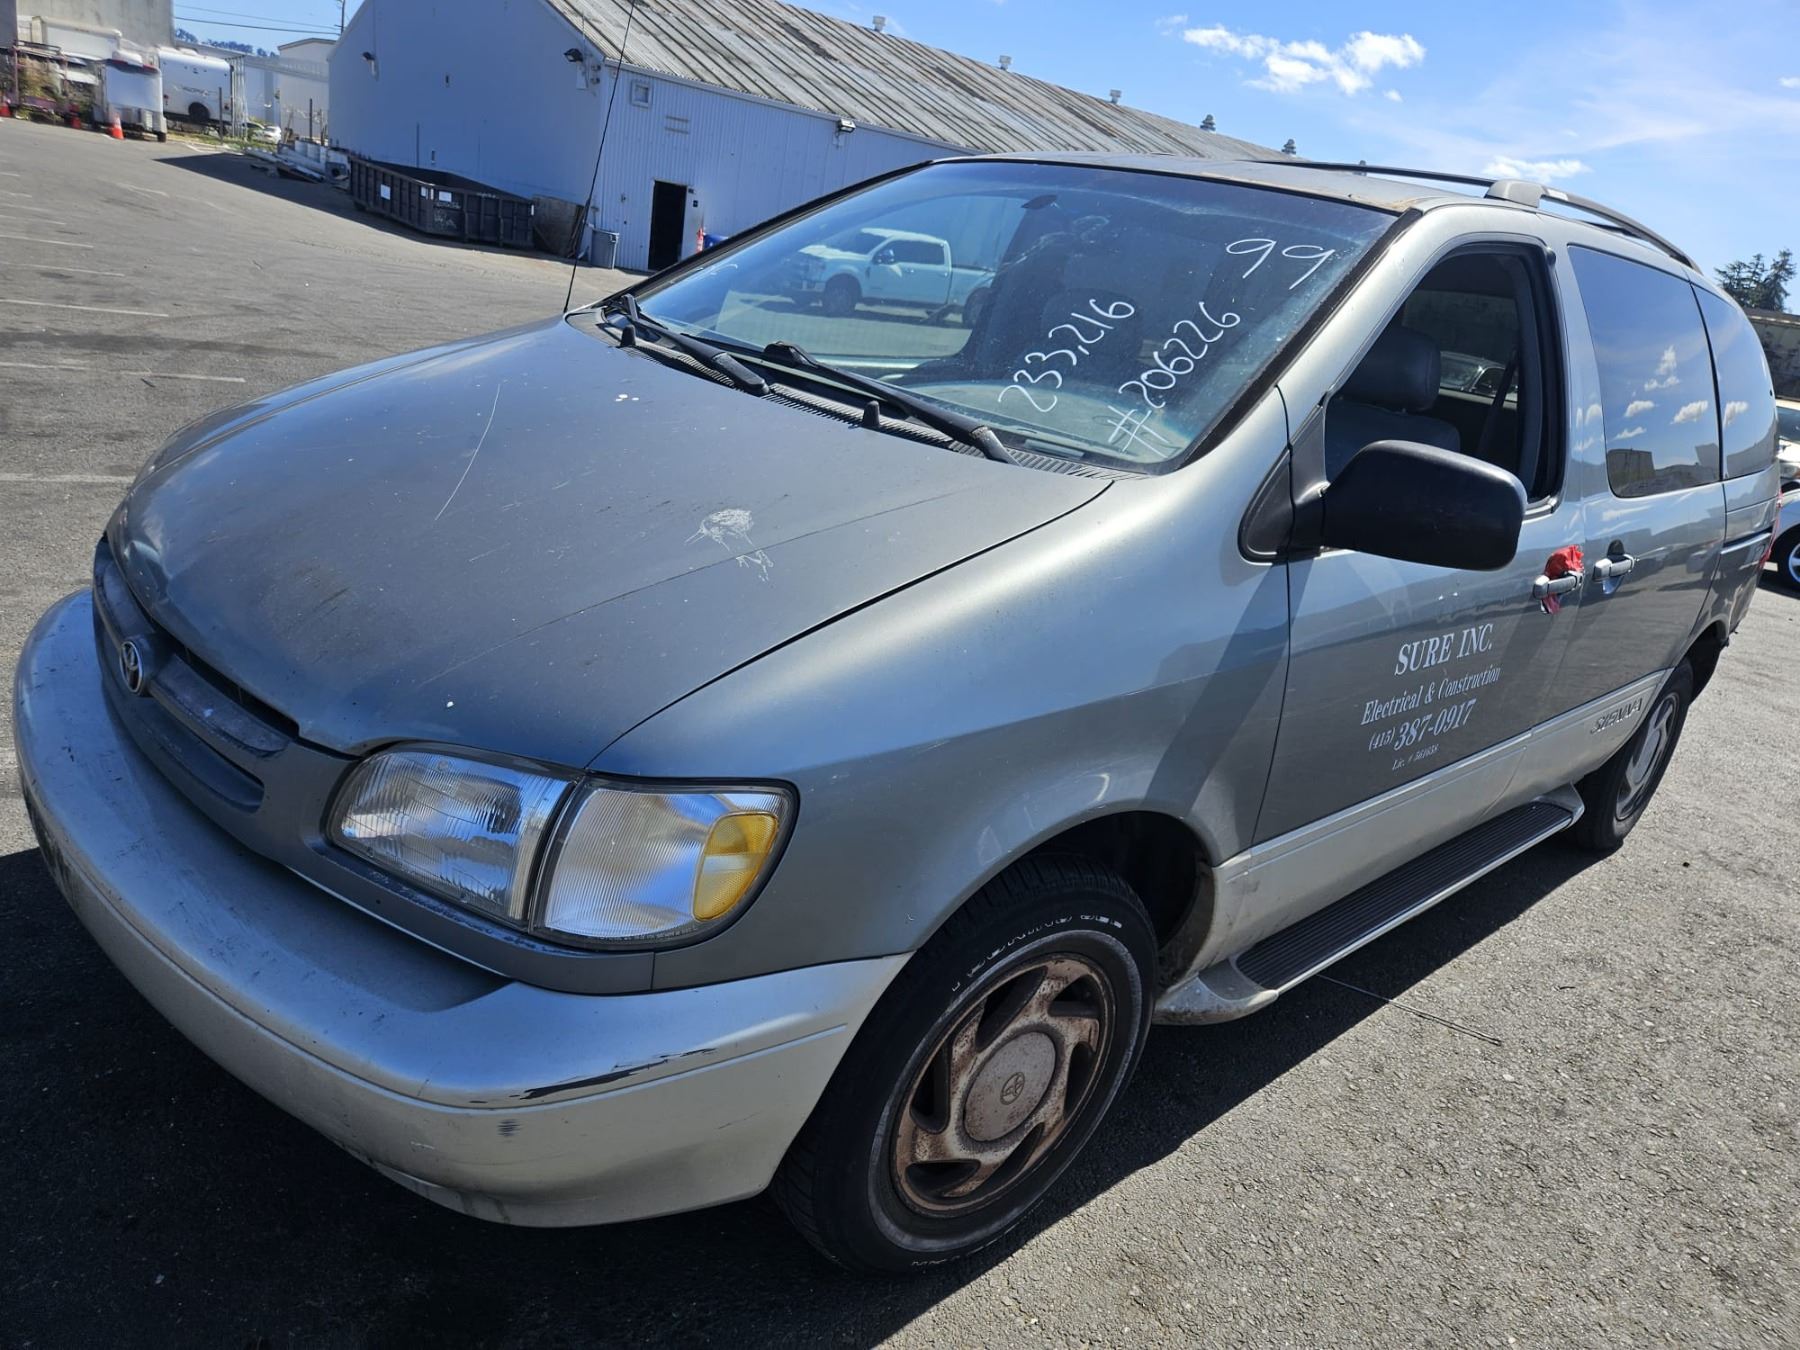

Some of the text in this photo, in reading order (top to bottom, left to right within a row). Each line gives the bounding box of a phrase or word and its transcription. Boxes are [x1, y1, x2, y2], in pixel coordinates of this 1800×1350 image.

[1225, 237, 1336, 290] 99
[1394, 623, 1494, 676] SURE INC.
[1360, 665, 1501, 726] Electrical & Construction
[1368, 698, 1477, 752] (415) 387-0917
